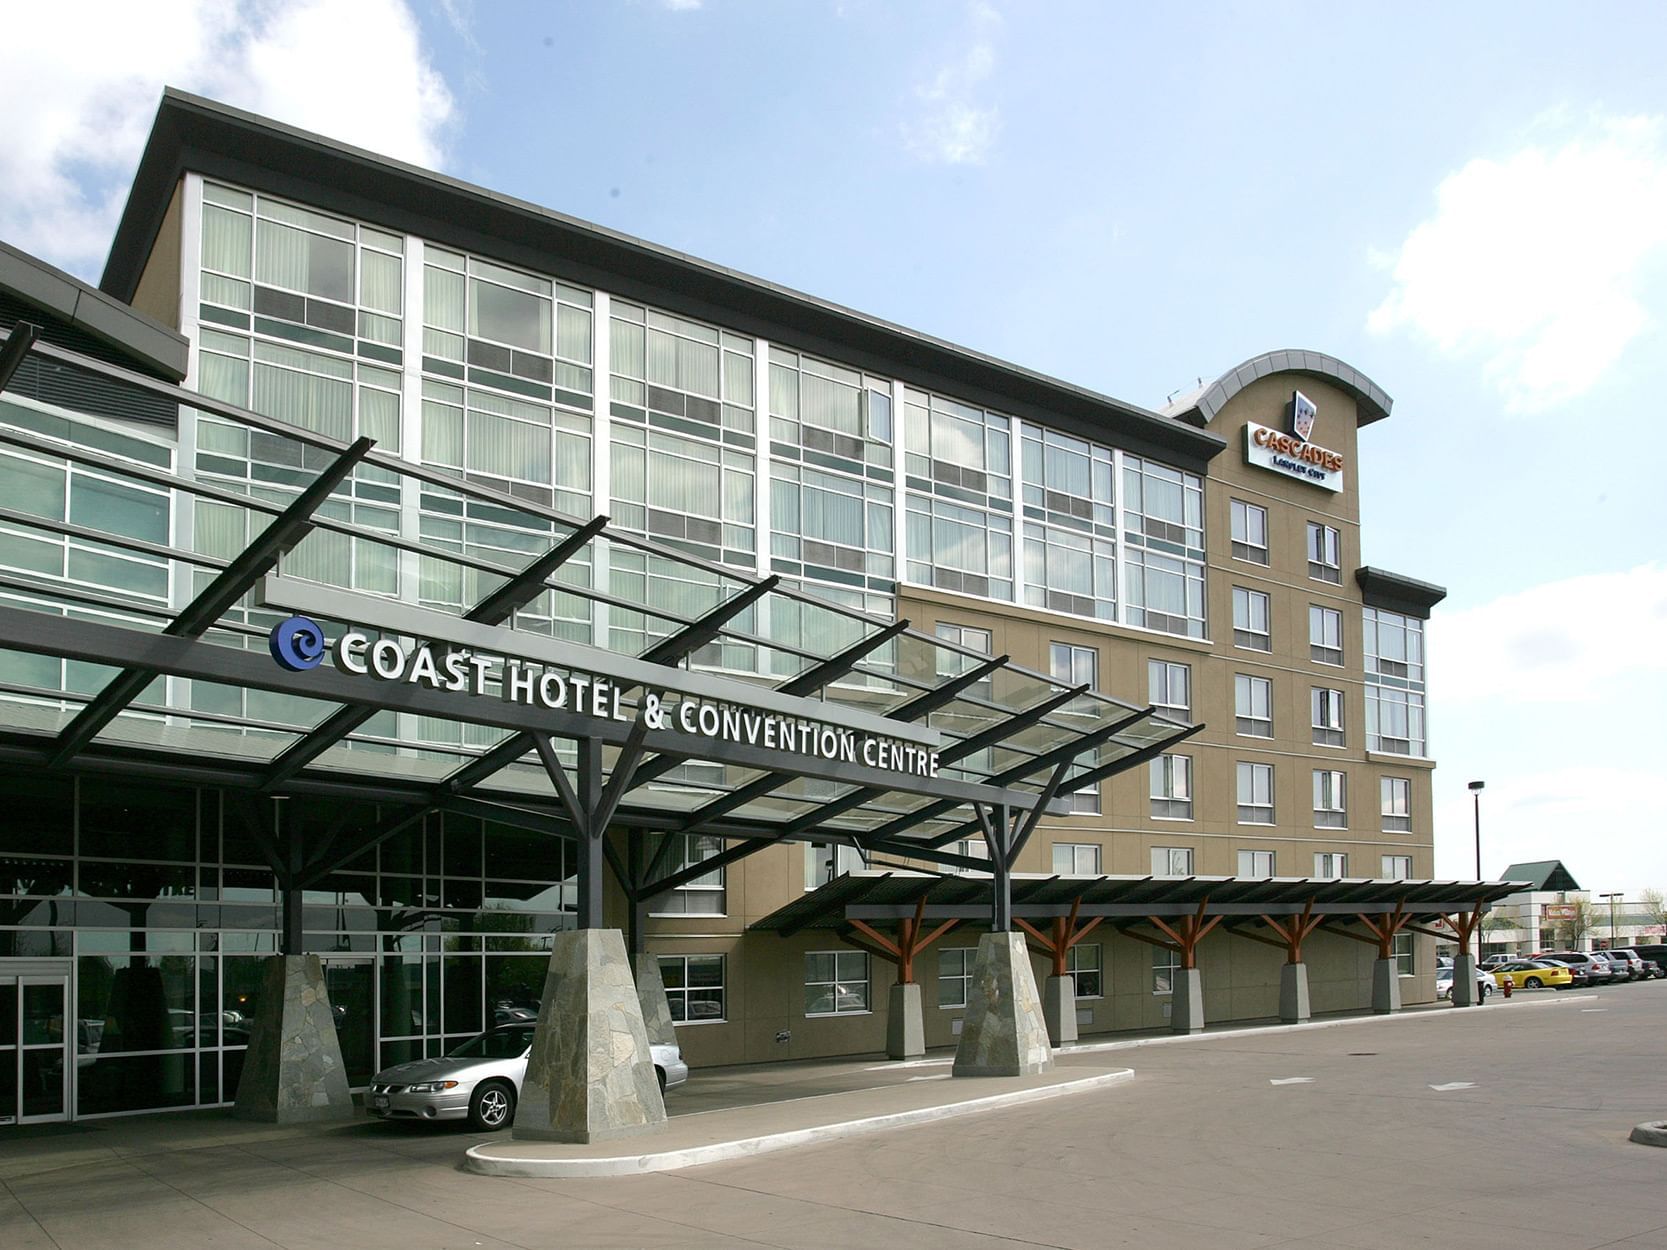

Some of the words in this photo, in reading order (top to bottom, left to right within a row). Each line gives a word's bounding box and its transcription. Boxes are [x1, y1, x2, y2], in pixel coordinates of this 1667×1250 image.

[1253, 427, 1343, 473] CASCADES
[338, 632, 494, 695] COAST
[509, 665, 628, 722] HOTEL
[645, 693, 666, 730] &
[680, 701, 856, 763] CONVENTION
[863, 738, 940, 779] CENTRE
